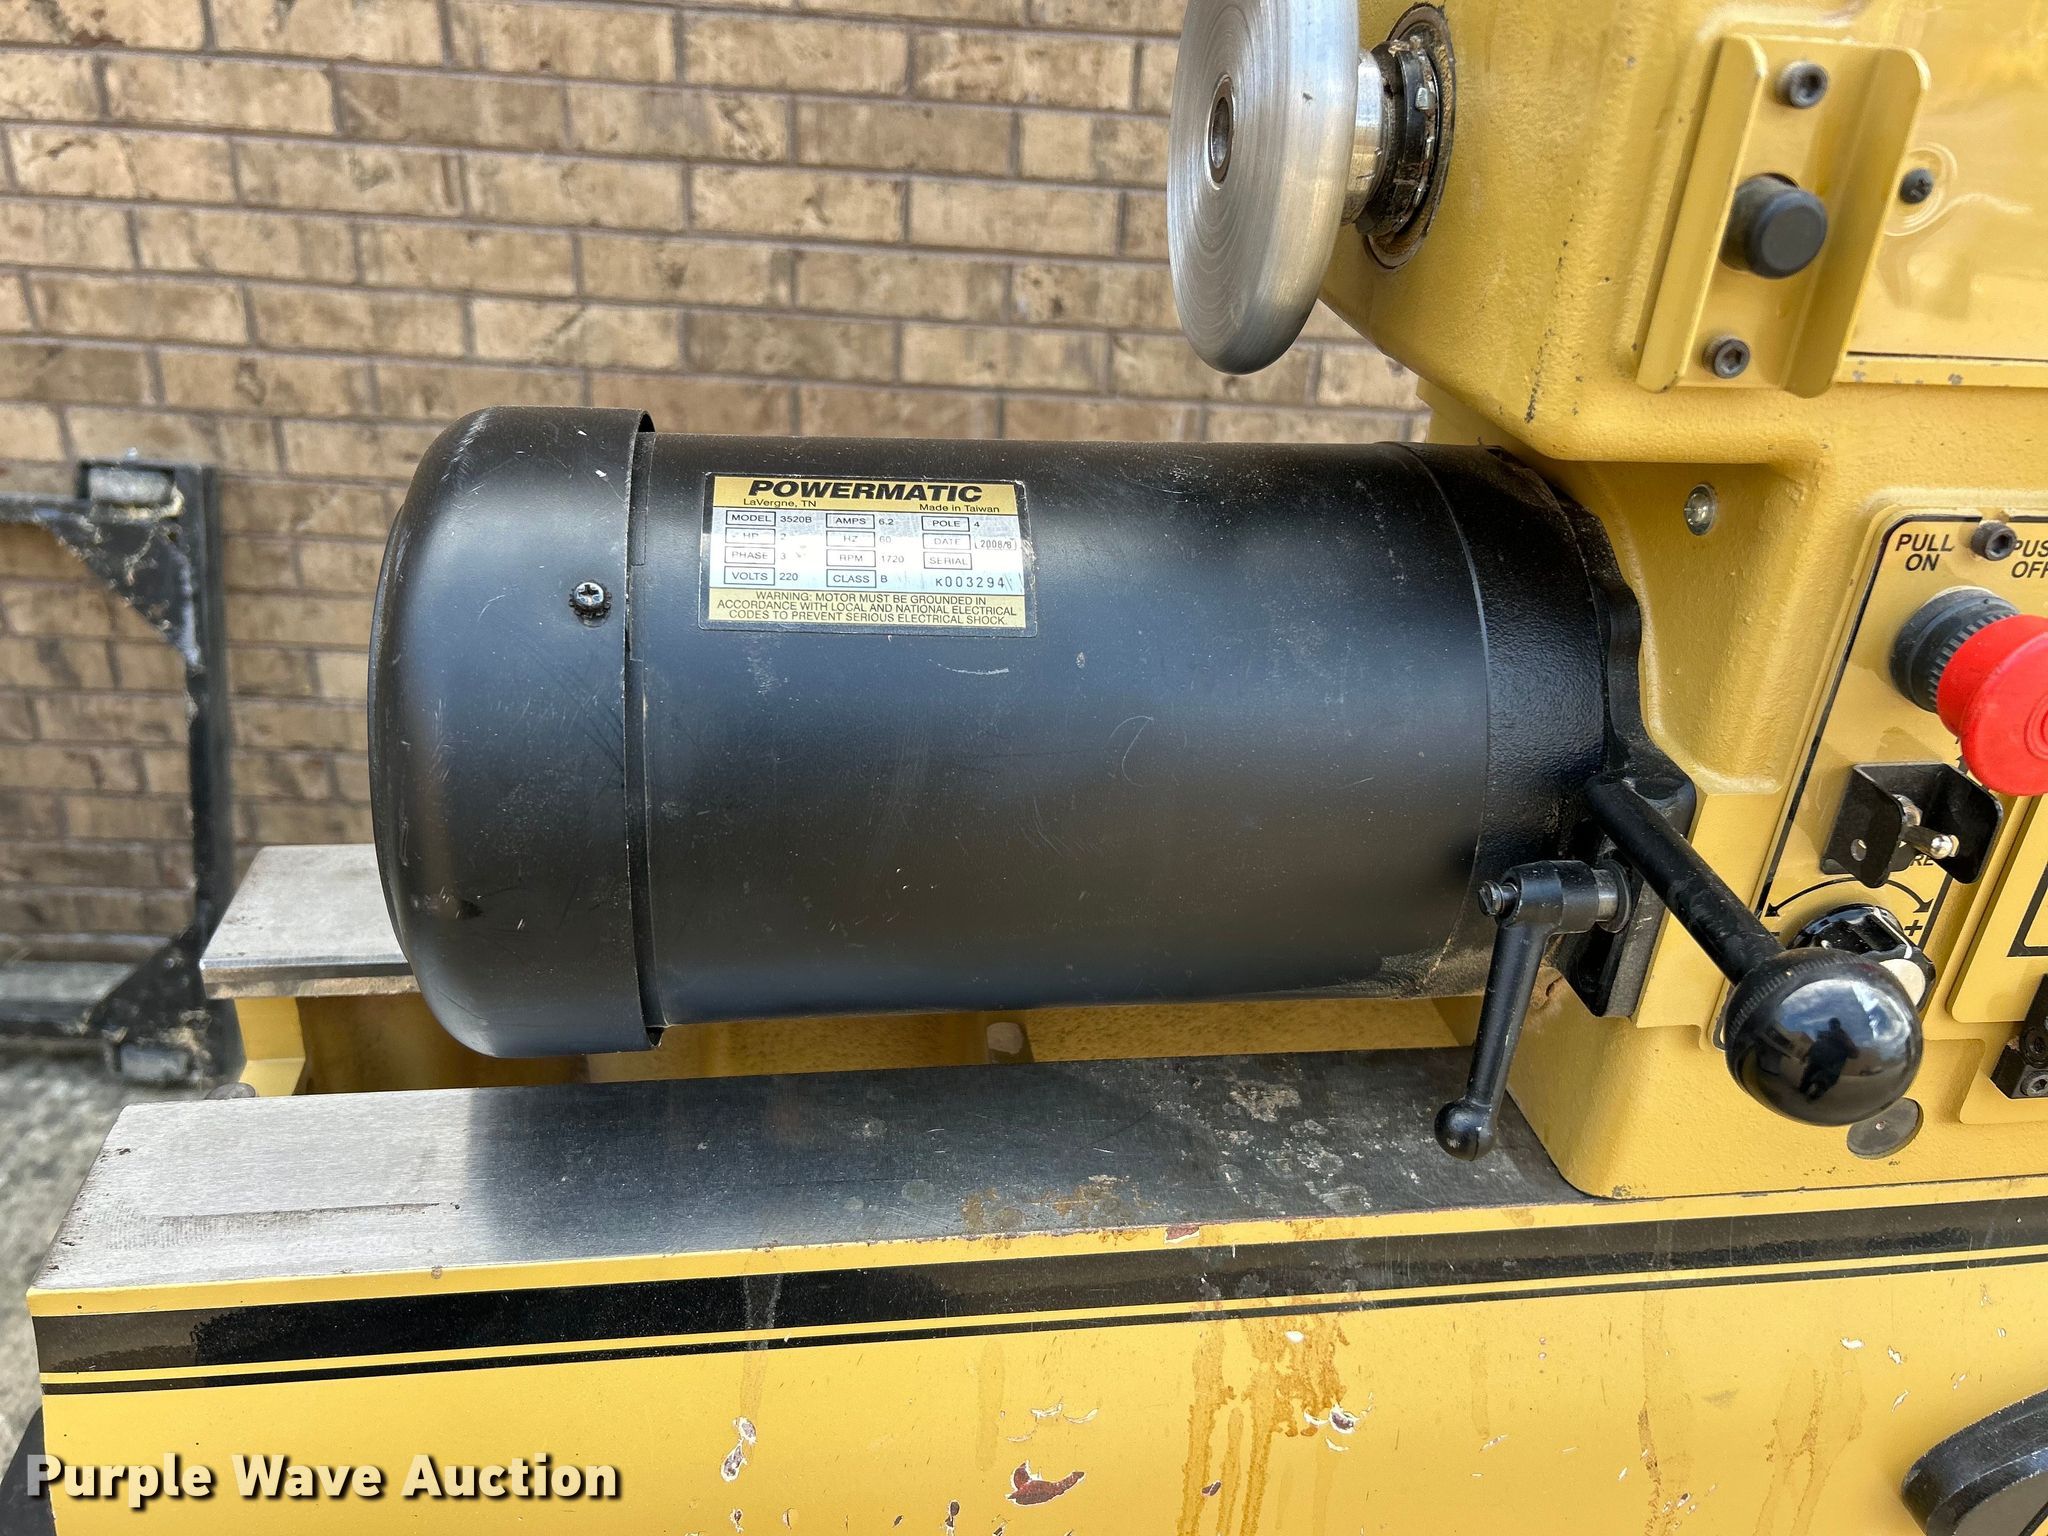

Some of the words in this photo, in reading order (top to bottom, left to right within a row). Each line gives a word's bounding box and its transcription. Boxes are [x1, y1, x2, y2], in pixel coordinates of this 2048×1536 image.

[748, 480, 983, 502] POWERMATIC
[743, 498, 798, 508] LaVergne,
[919, 503, 949, 512] Made
[952, 504, 961, 512] in
[964, 505, 1000, 513] Taiwan
[731, 514, 772, 522] MODEL
[780, 515, 813, 523] 3520B
[835, 517, 867, 525] AMPS
[934, 537, 961, 545] DATE
[1895, 534, 1955, 552] PULL
[731, 551, 768, 560] PHASE
[780, 552, 787, 560] 3
[839, 554, 863, 562] RPM
[881, 555, 905, 564] 1720
[929, 556, 968, 566] SERIAL
[1905, 554, 1940, 571] ON
[731, 571, 768, 581] VOLTS
[779, 572, 799, 581] 220
[833, 574, 870, 583] CLASS
[880, 575, 888, 583] B
[756, 591, 813, 601] WARNING:
[815, 592, 856, 602] MOTOR
[859, 594, 890, 604] MUST
[893, 595, 907, 604] BE
[910, 595, 972, 605] GROUNDED
[975, 597, 987, 605] IN
[717, 599, 797, 610] ACCORDANCE
[799, 602, 828, 611] WITH
[831, 603, 867, 612] LOCAL
[869, 603, 893, 613] AND
[895, 604, 949, 614] NATIONAL
[952, 606, 1017, 616] ELECTRICAL
[729, 609, 770, 619] CODES
[773, 610, 789, 620] TO
[791, 611, 842, 621] PREVENT
[845, 612, 895, 623] SERIOUS
[897, 614, 964, 624] ELECTRICAL
